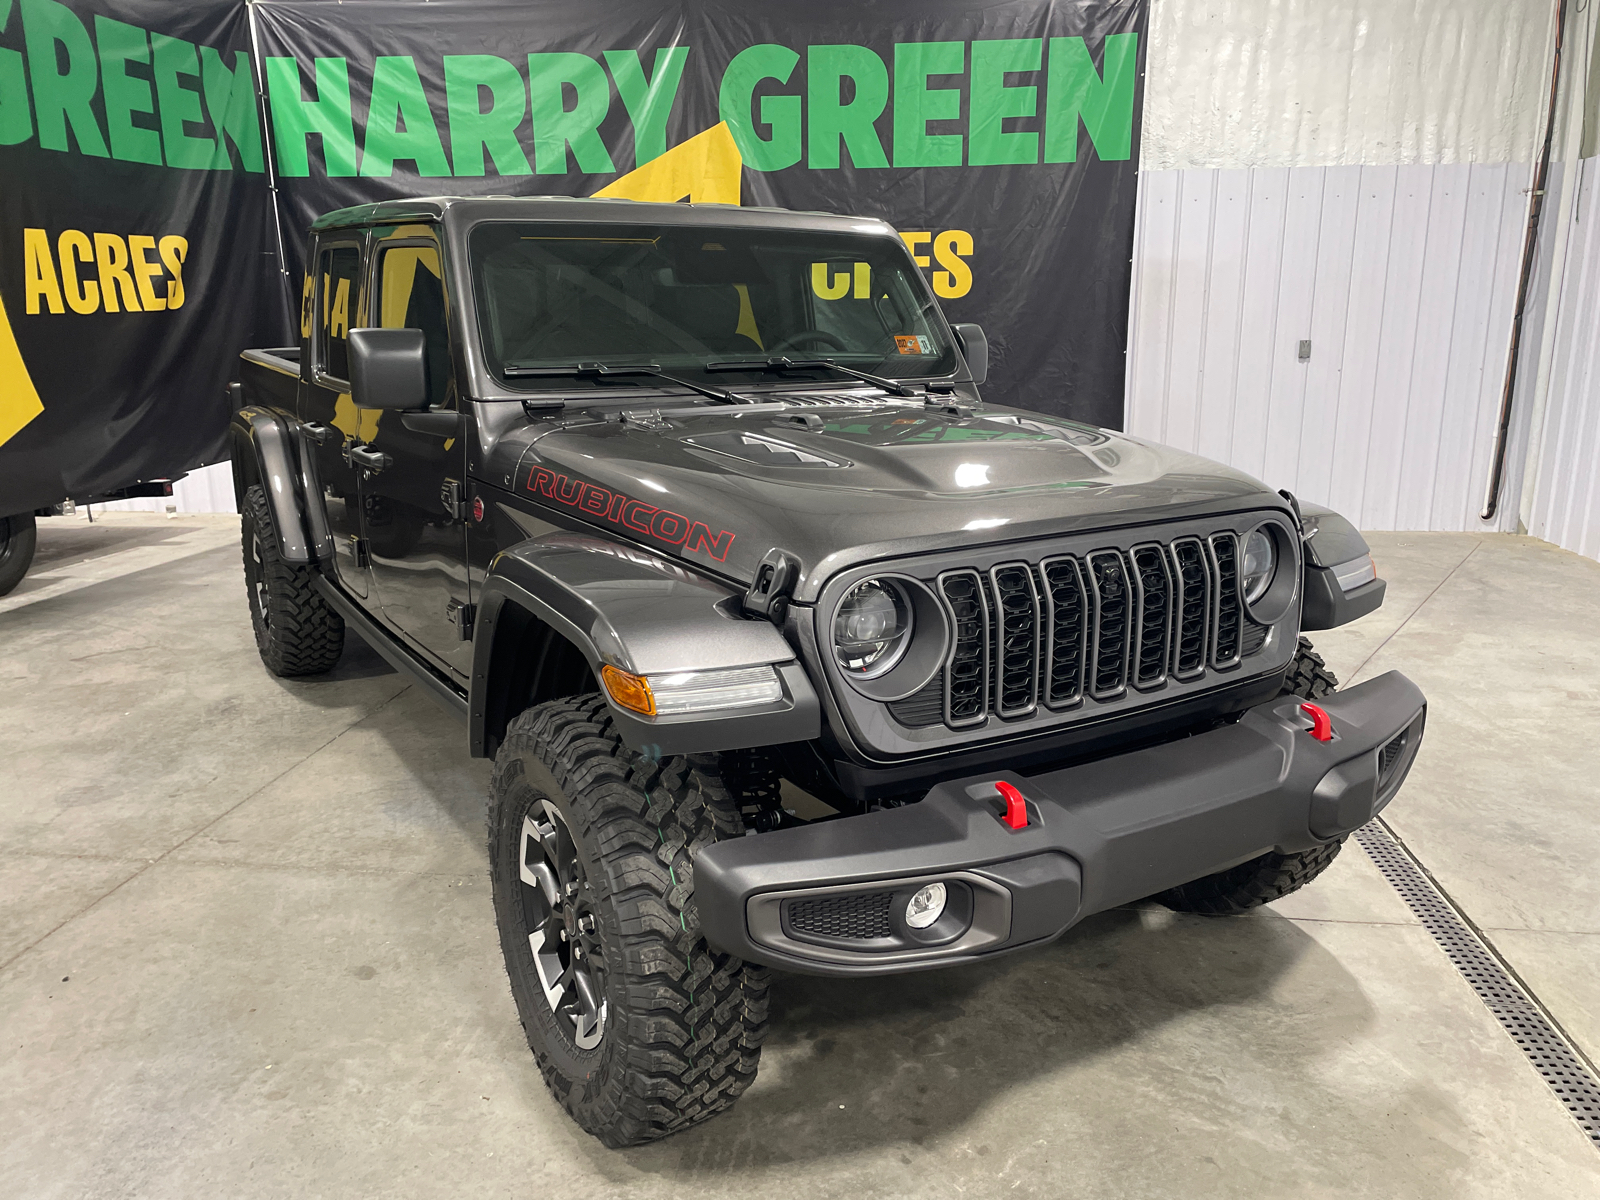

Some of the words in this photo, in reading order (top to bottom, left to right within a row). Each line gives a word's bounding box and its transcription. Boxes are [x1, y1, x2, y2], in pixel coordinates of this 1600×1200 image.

[266, 45, 690, 178] HARRY
[718, 32, 1138, 171] GREEN
[24, 228, 188, 315] ACRES
[527, 465, 735, 562] RUBICON
